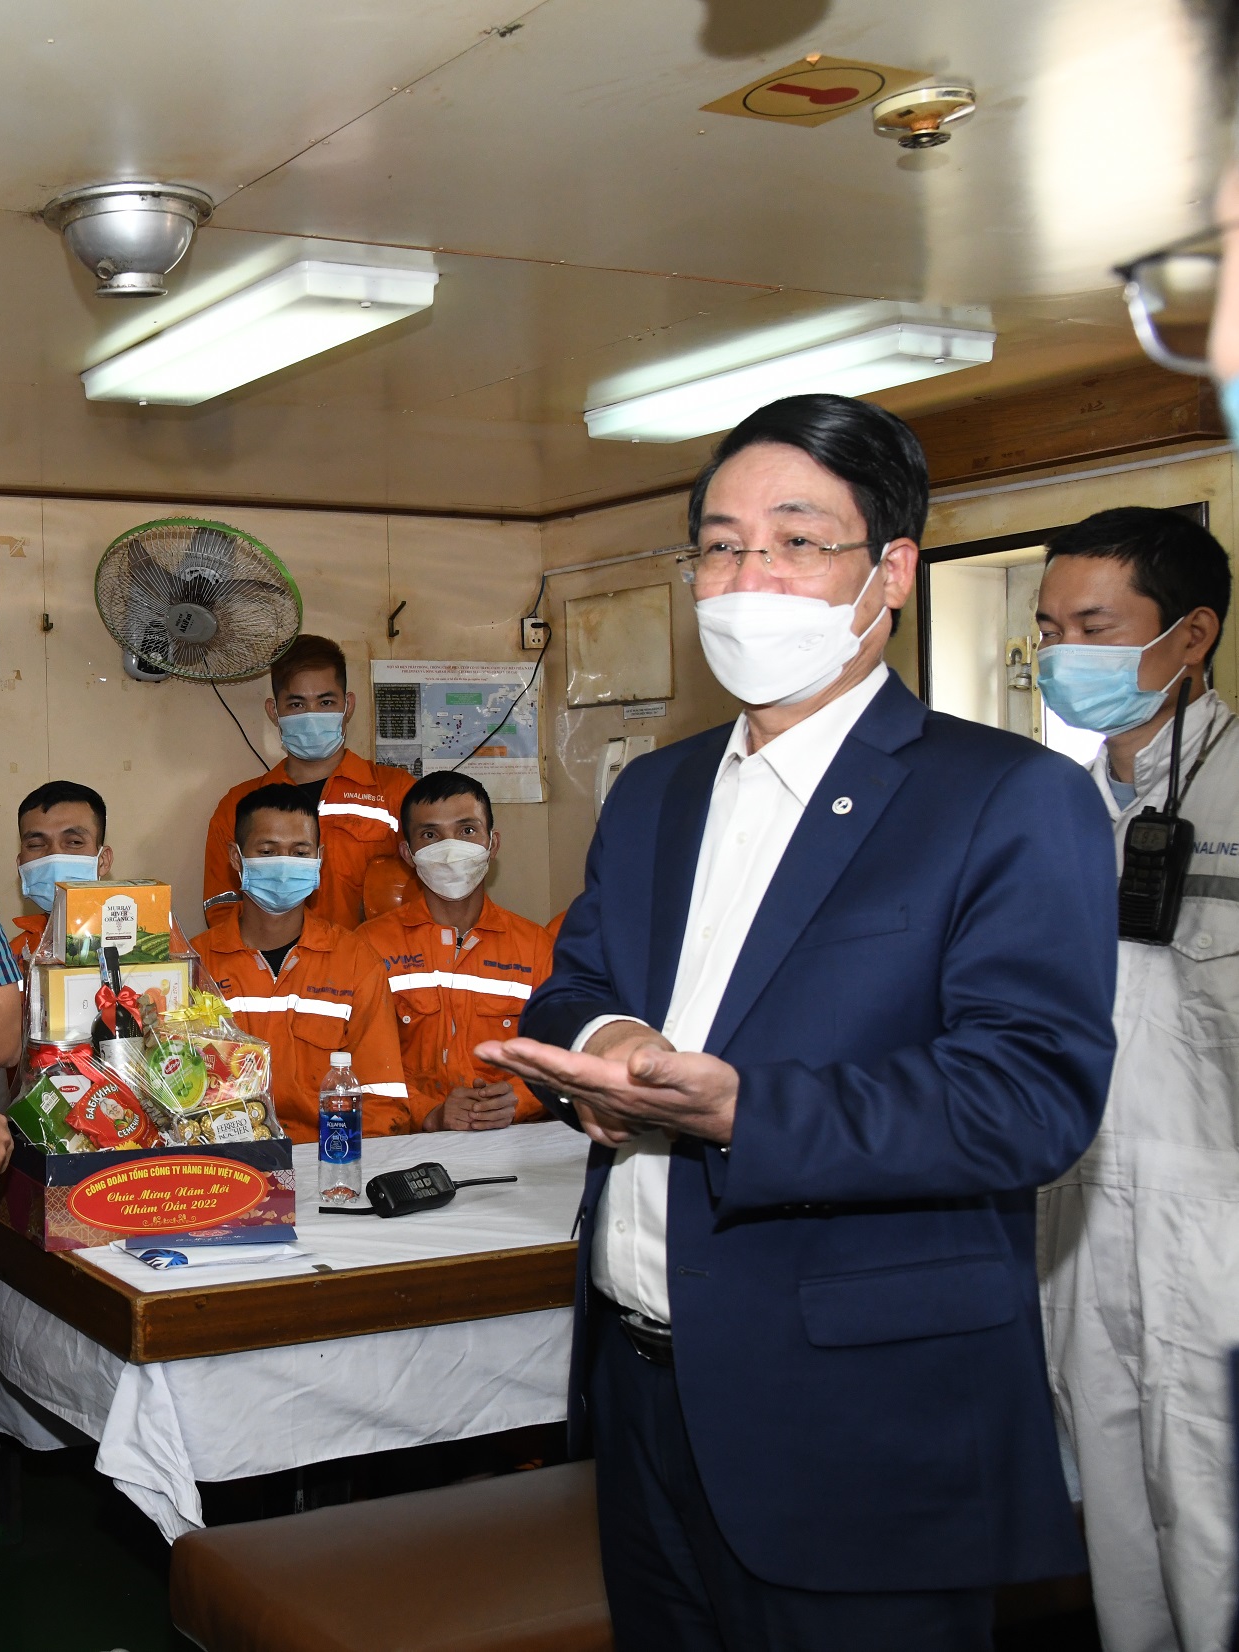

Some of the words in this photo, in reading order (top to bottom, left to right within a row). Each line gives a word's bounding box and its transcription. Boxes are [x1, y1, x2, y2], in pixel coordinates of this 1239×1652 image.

[343, 792, 376, 801] VINALINES
[1193, 841, 1239, 856] NALINE
[86, 1084, 119, 1120] БАБКИНЫ
[117, 1113, 140, 1138] СЕМЕЧКИ
[216, 1118, 248, 1133] FERRERO
[218, 1127, 250, 1140] ROCHER
[85, 1181, 106, 1197] CÔNG
[107, 1174, 128, 1186] ĐOÀN
[128, 1168, 149, 1181] TỔNG
[150, 1166, 170, 1177] CÔNG
[172, 1166, 181, 1174] TY
[182, 1164, 202, 1174] HÀNG
[203, 1164, 216, 1175] HẢI
[217, 1167, 233, 1179] VIỆT
[233, 1171, 251, 1184] NAM
[107, 1191, 135, 1202] Chúc
[137, 1189, 171, 1201] Mừng
[175, 1186, 204, 1197] Năm
[206, 1183, 230, 1195] Mới
[120, 1204, 157, 1215] Nhâm
[162, 1201, 187, 1212] Dần
[191, 1199, 217, 1209] 2022
